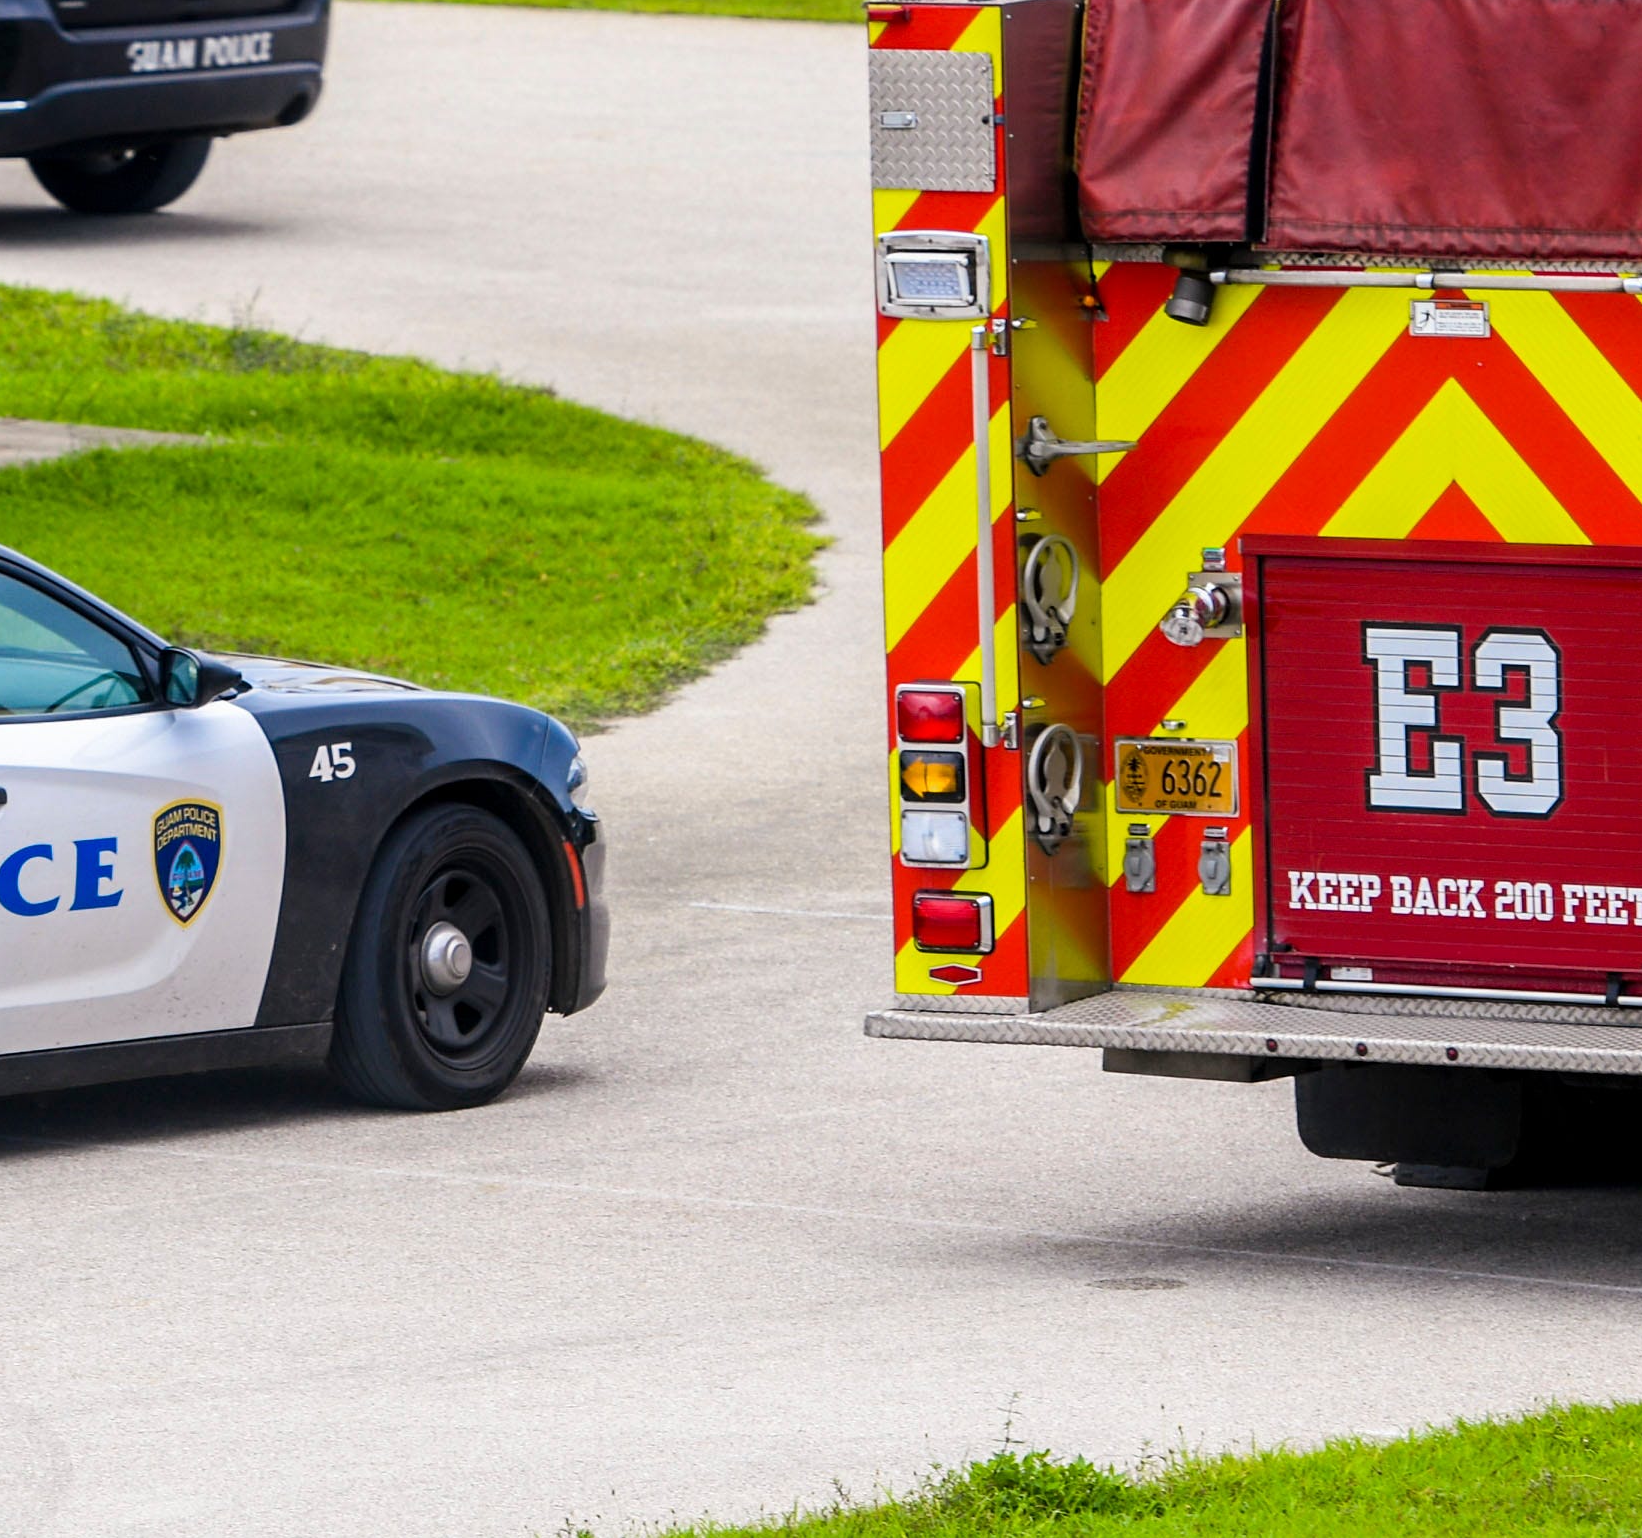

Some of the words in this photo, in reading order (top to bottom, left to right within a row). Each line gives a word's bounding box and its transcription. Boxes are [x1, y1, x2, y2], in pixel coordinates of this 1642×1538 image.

[202, 31, 272, 67] POLICE
[1361, 620, 1565, 820] E3
[308, 741, 357, 782] 45
[1162, 759, 1222, 798] 6362
[157, 808, 183, 835] GUAM
[184, 807, 217, 827] POLICE
[1154, 799, 1167, 809] OF
[1170, 800, 1197, 810] GUAM
[157, 823, 217, 851] DEPARTMENT
[1288, 870, 1381, 912] KEEP
[1390, 875, 1487, 919] BACK
[1494, 881, 1553, 922] 200
